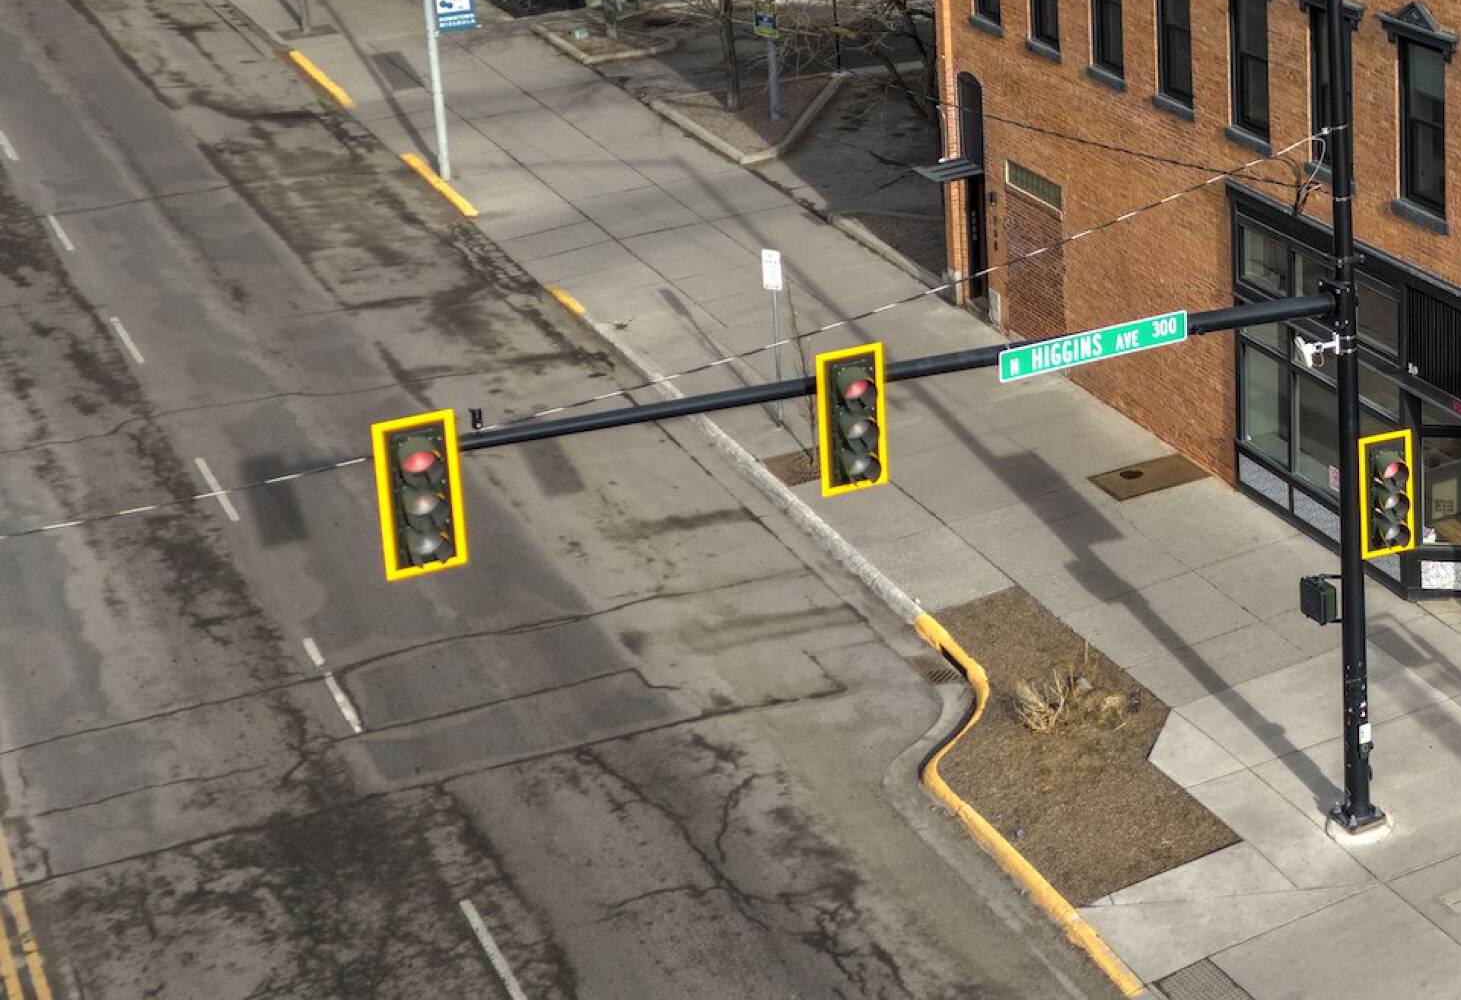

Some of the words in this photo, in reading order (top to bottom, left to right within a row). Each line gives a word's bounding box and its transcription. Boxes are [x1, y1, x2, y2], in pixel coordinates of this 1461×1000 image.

[1009, 357, 1020, 376] N
[1031, 333, 1103, 371] HIGGINS
[1115, 330, 1140, 351] AVE
[1152, 317, 1177, 338] 300
